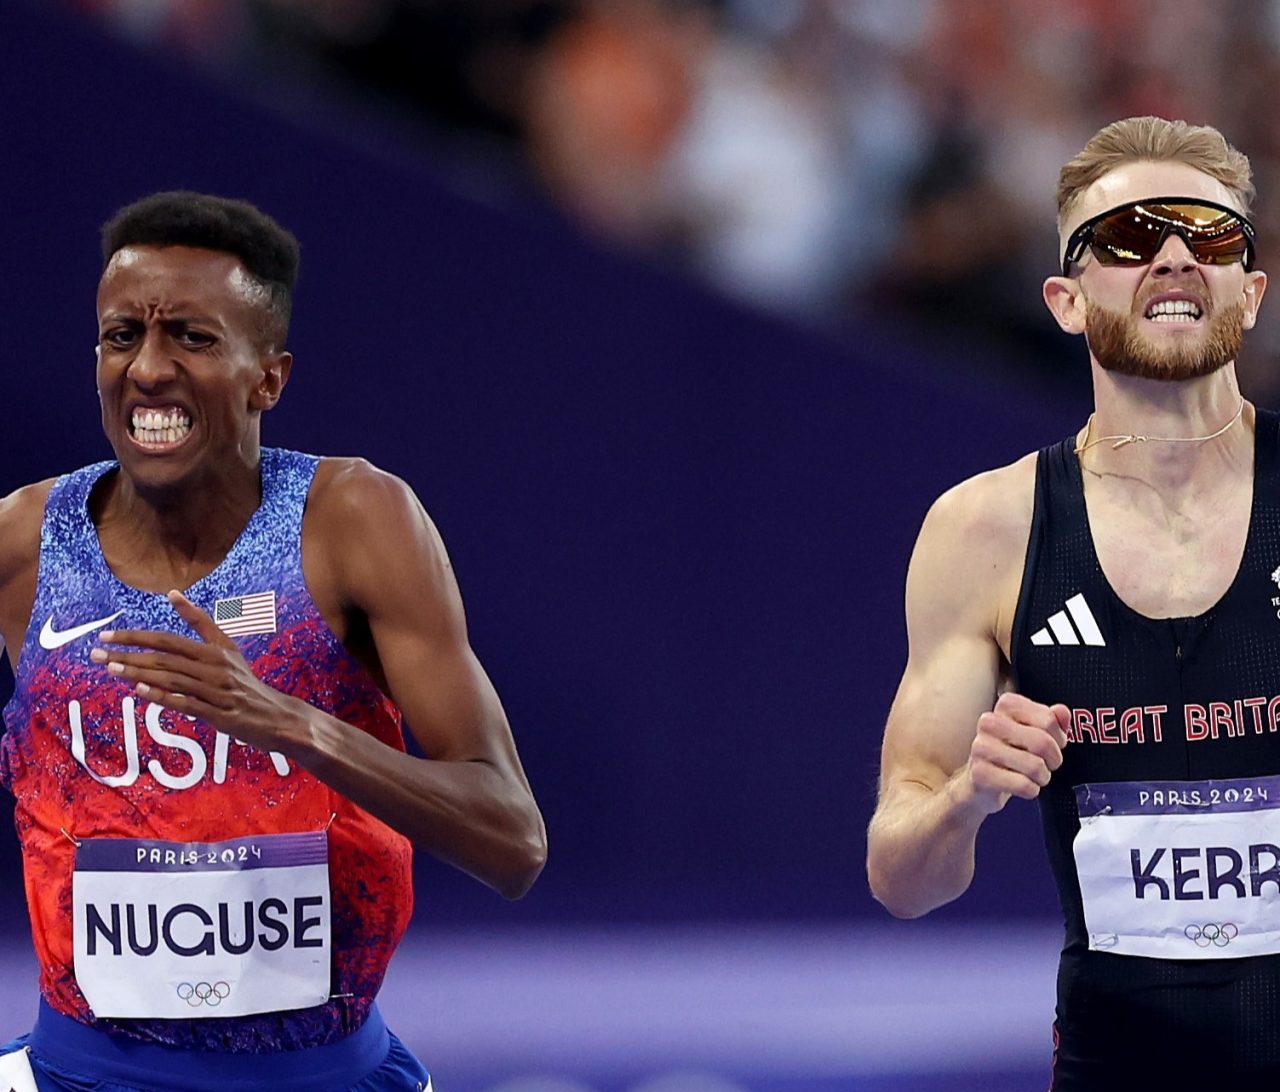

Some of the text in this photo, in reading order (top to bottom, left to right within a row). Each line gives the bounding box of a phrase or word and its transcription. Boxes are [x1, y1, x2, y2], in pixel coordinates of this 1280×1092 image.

[1066, 704, 1168, 744] REAT
[1139, 786, 1268, 806] PARIS 2024
[137, 845, 262, 865] PARIS 2024
[85, 895, 324, 957] NUGUSE
